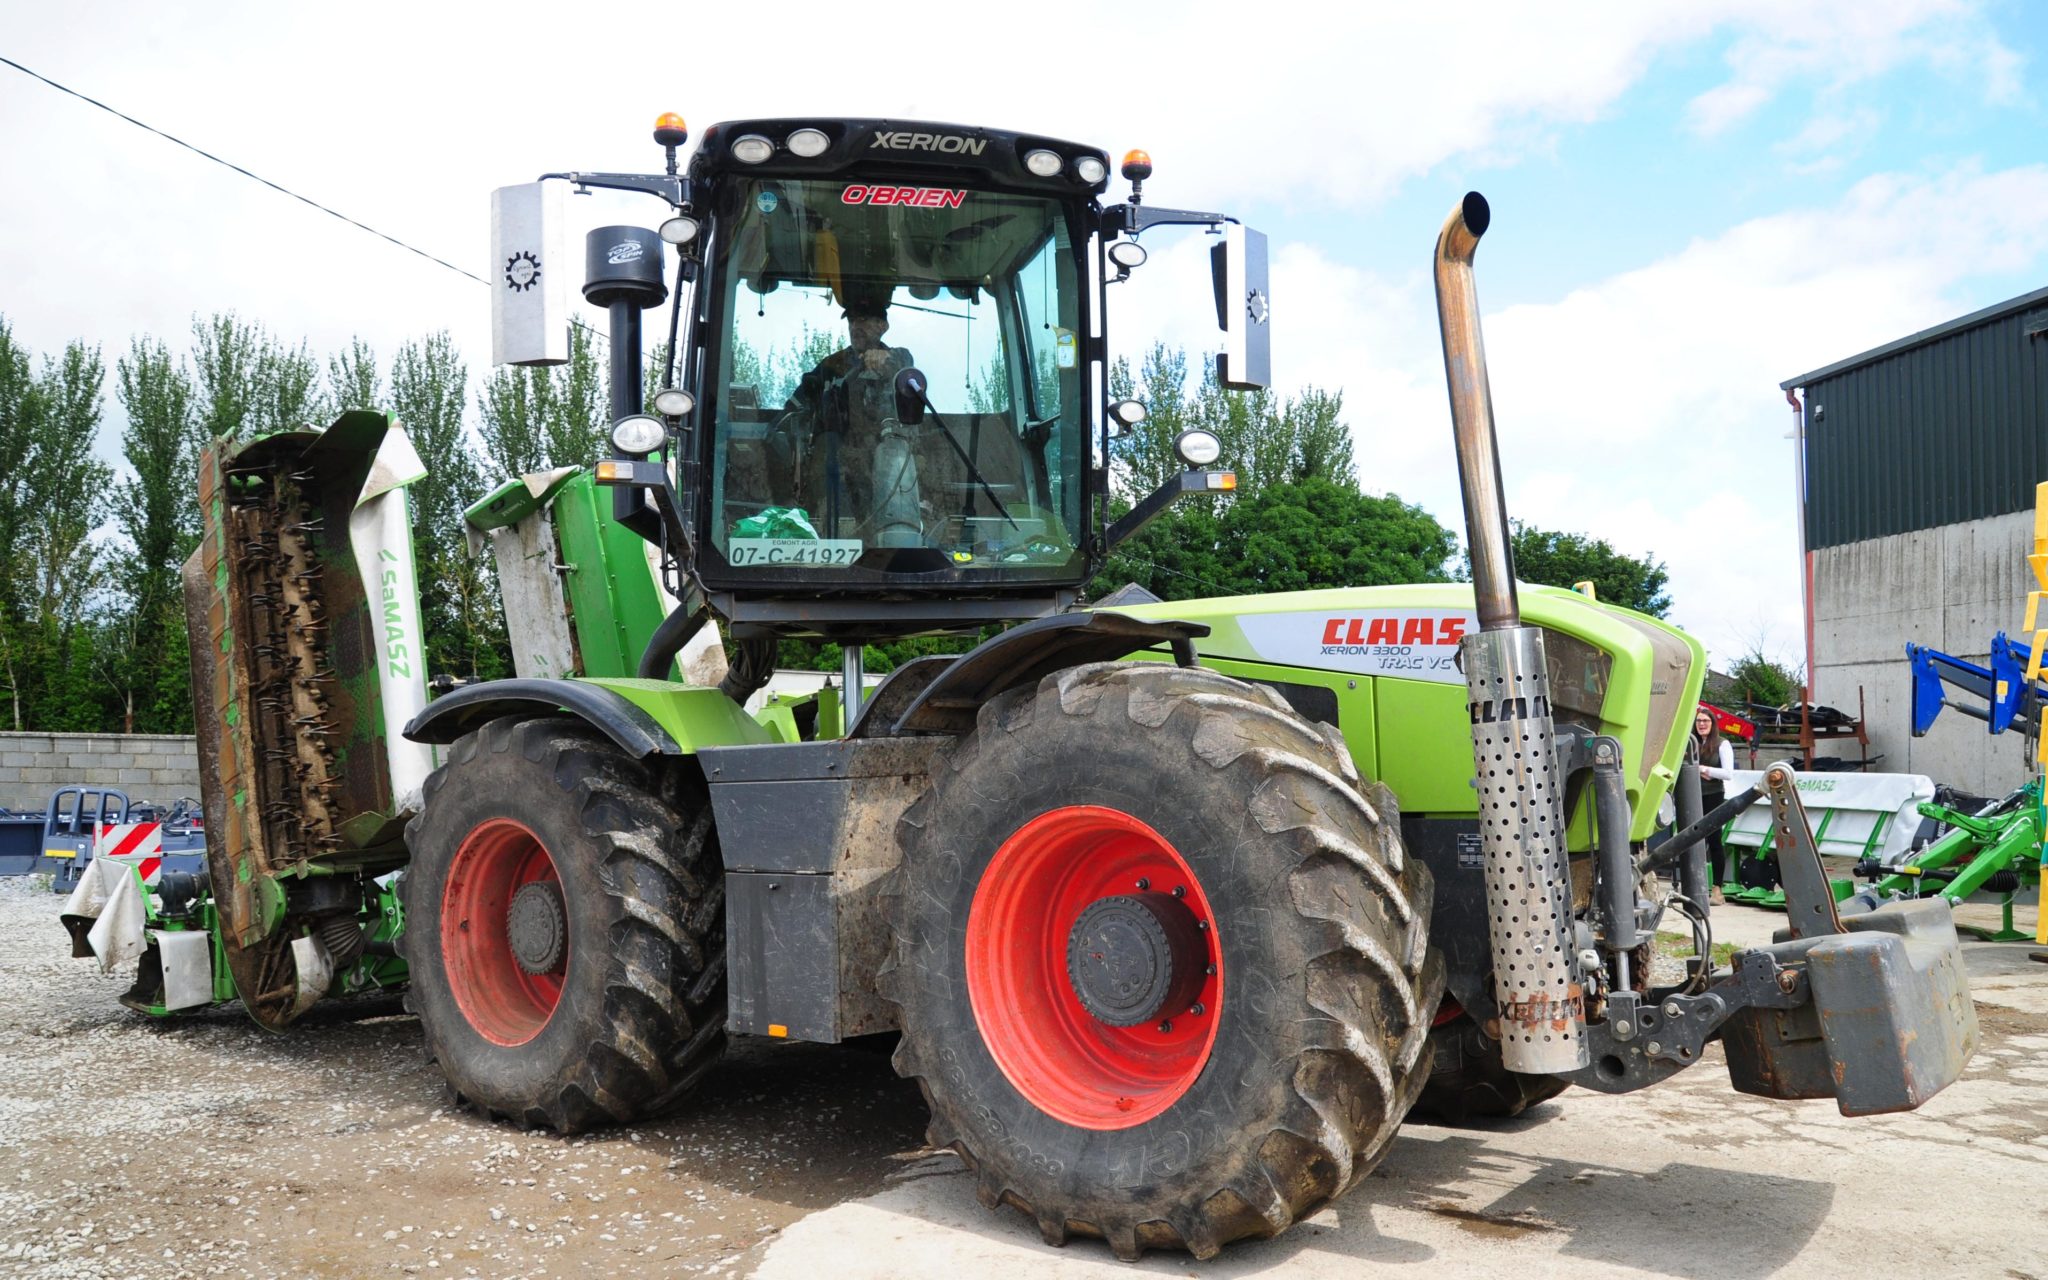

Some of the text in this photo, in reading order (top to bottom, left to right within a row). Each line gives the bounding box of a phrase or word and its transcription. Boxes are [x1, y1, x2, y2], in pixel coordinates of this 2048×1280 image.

[870, 131, 987, 156] XERION
[841, 185, 967, 208] O'BRIEN
[732, 547, 860, 565] 07-C-41927
[381, 569, 411, 679] SaMASZ
[1322, 618, 1466, 645] CLAAS
[1320, 646, 1411, 656] XERION 3300
[1378, 656, 1453, 669] TRAC VC
[1470, 695, 1550, 724] CLAA
[1796, 779, 1836, 791] SaMASZ
